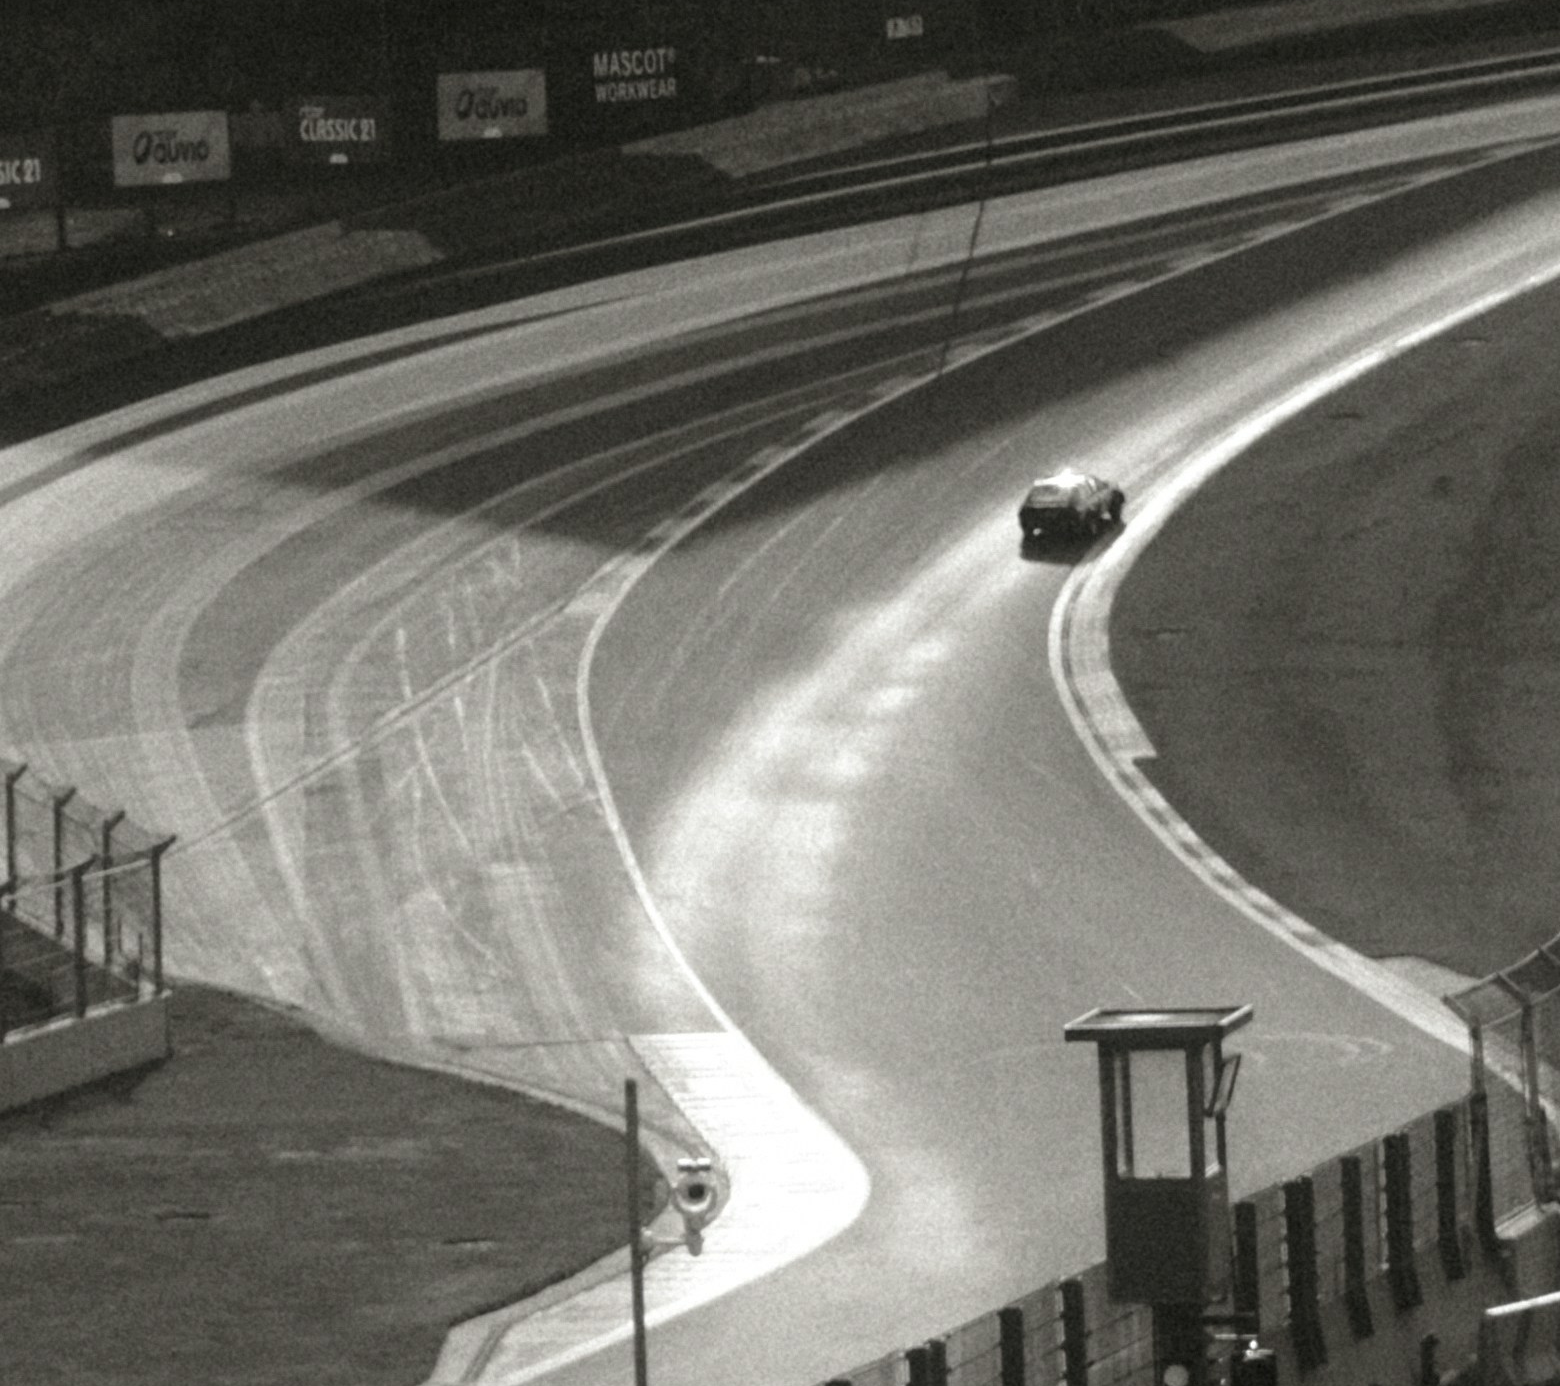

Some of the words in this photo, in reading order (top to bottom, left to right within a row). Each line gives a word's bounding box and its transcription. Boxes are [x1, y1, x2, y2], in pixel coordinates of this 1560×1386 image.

[595, 77, 678, 103] WORKWEAR
[300, 118, 358, 142] CLASSIC
[23, 158, 41, 184] 21
